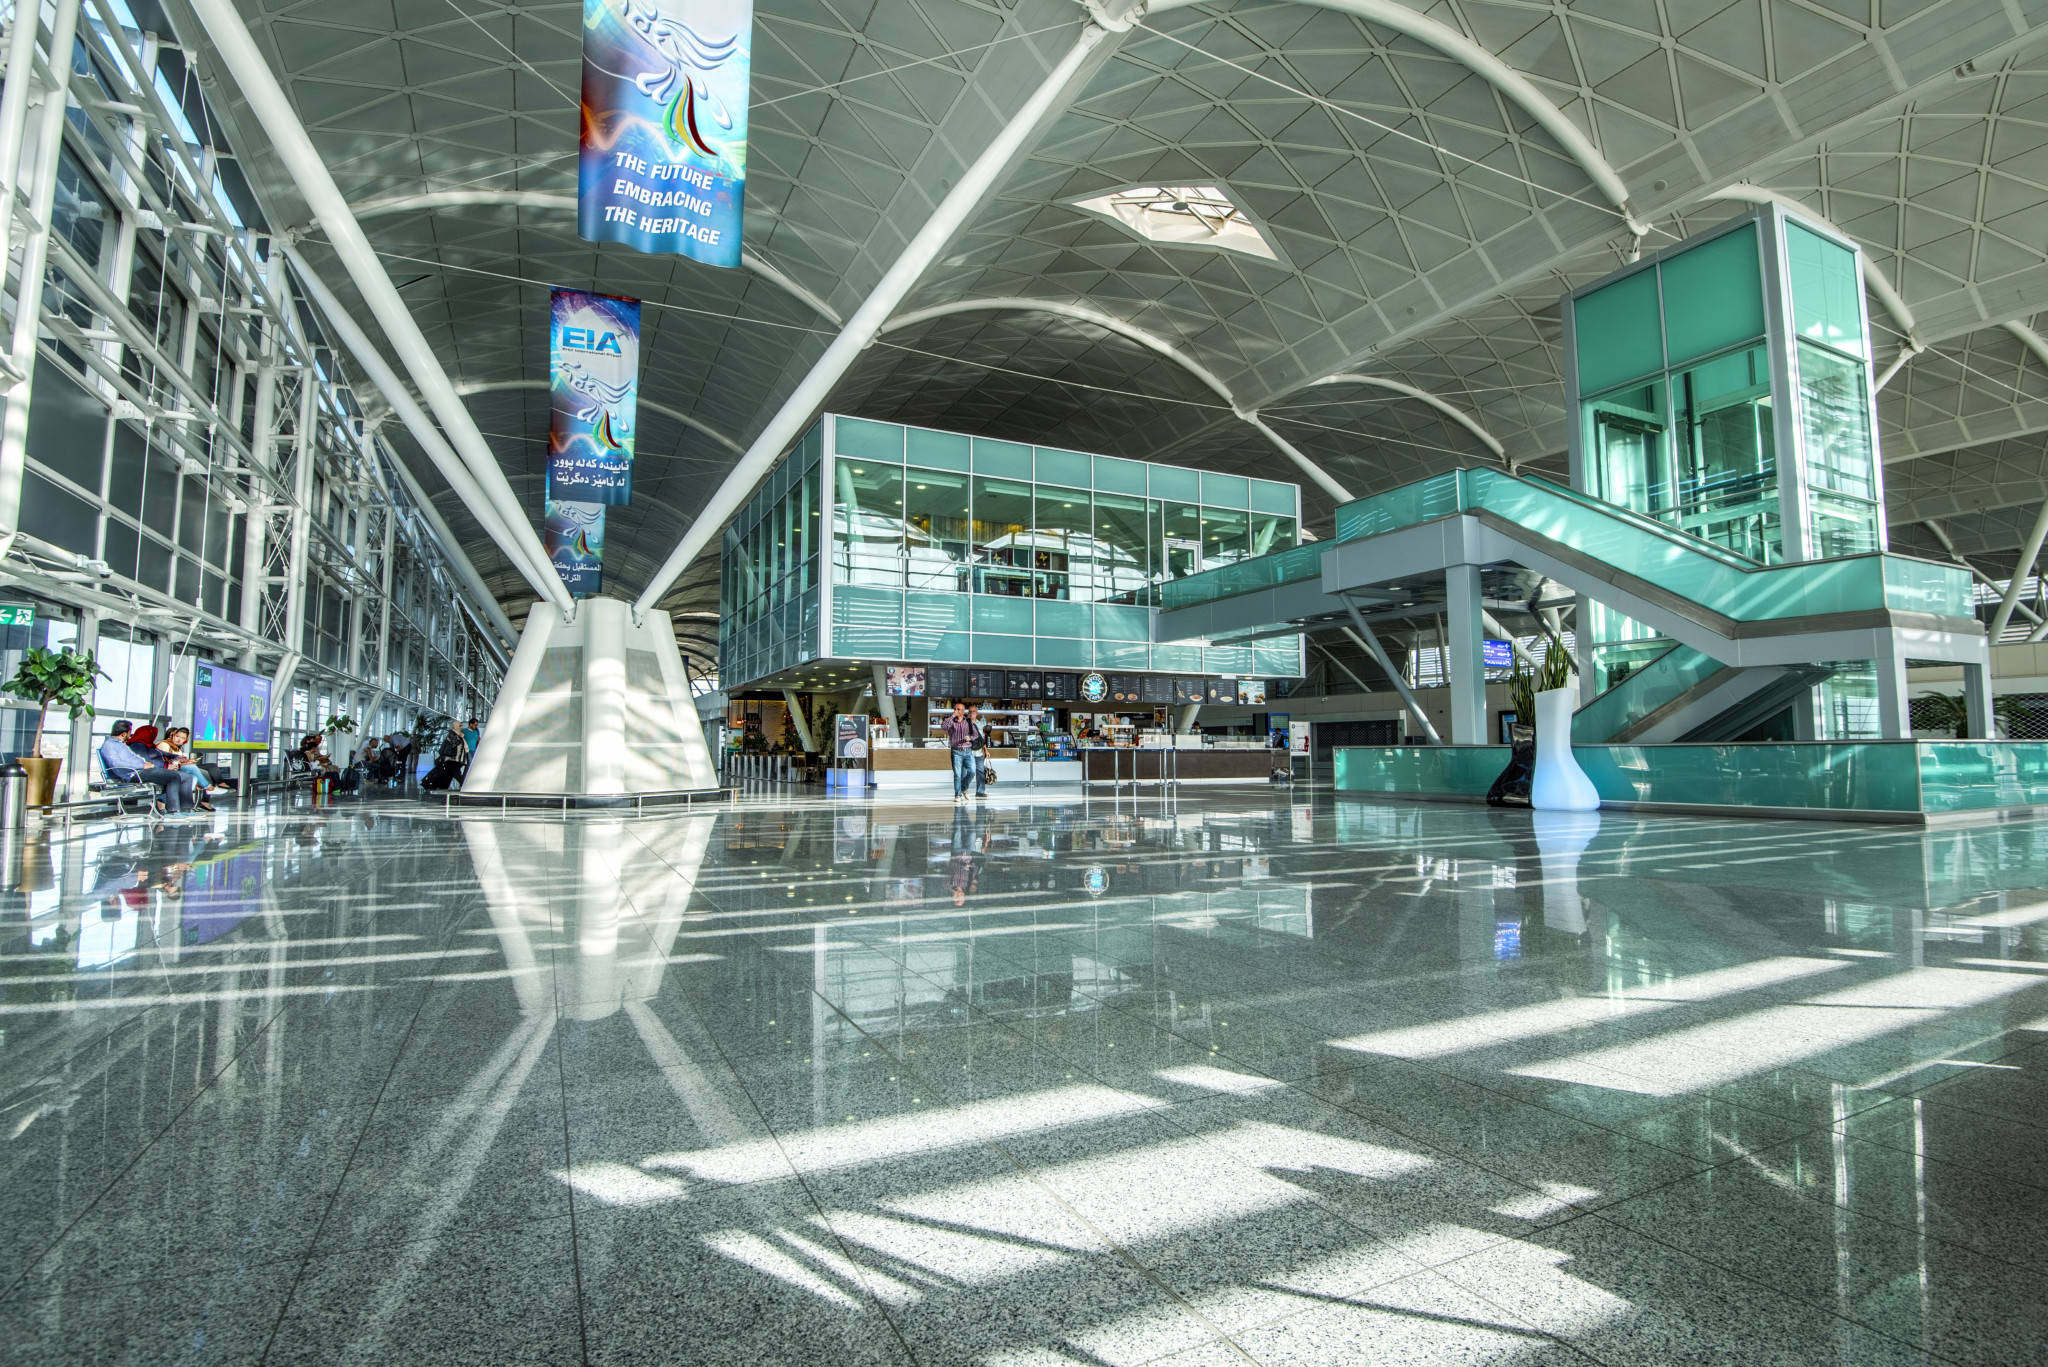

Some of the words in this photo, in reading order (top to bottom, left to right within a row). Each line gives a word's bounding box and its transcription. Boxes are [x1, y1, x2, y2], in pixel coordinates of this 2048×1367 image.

[616, 152, 648, 176] THE
[650, 164, 714, 190] FUTURE
[613, 178, 713, 217] EMBRACING
[605, 206, 637, 226] THE
[639, 216, 720, 246] HERITAGE
[562, 325, 622, 354] EIA
